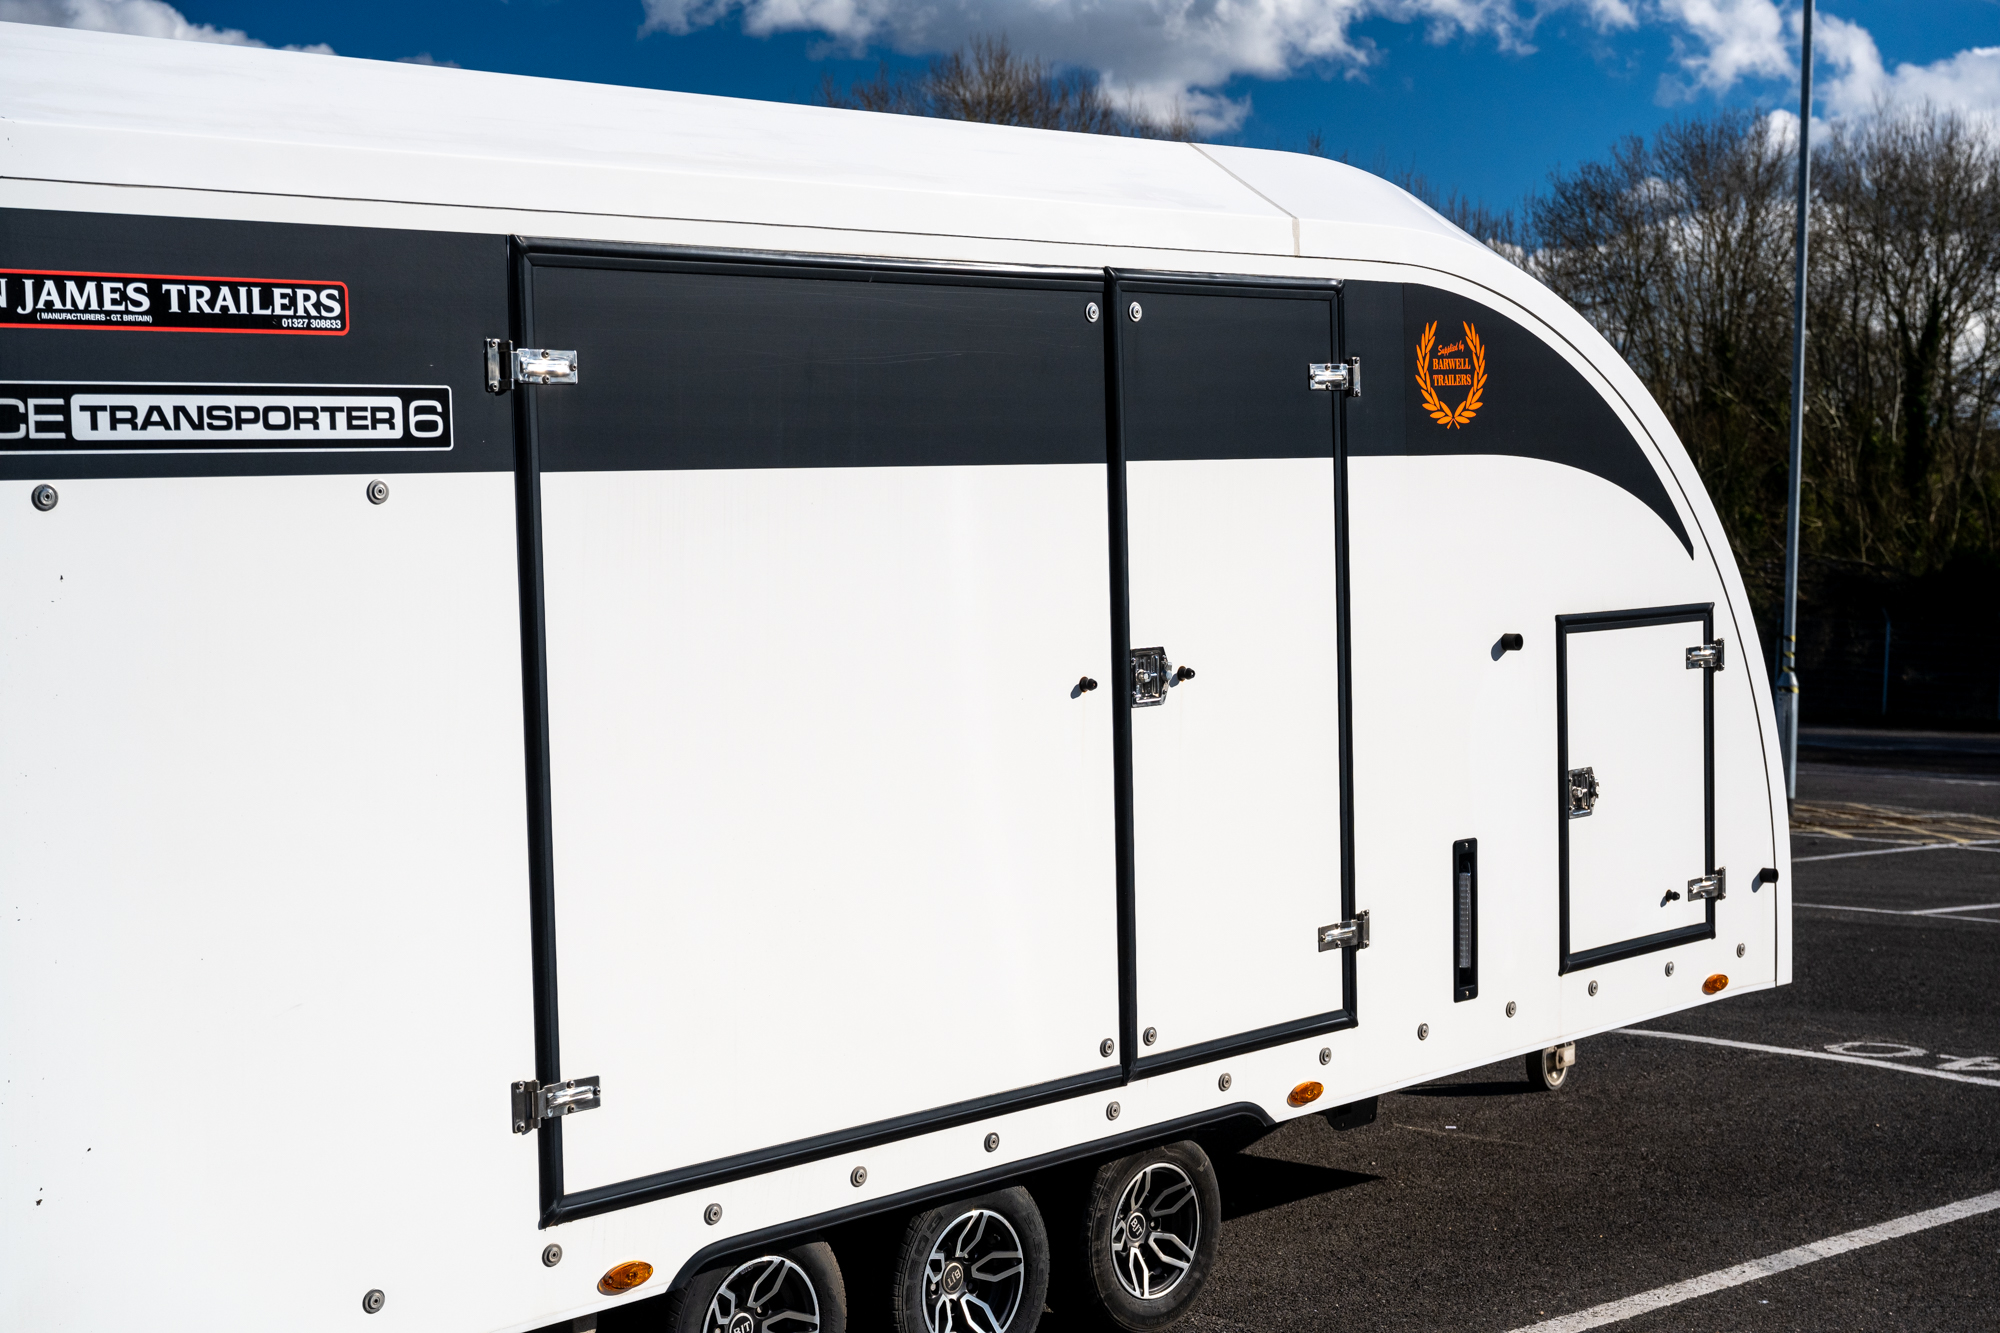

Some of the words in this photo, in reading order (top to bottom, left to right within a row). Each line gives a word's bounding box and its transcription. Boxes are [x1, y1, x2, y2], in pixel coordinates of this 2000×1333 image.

[16, 278, 151, 315] JAMES
[161, 283, 342, 318] TRAILERS
[123, 314, 153, 324] BRITAIN)
[281, 318, 309, 328] 01327
[310, 319, 342, 329] 308833
[1438, 343, 1458, 356] Supplied
[1459, 340, 1465, 352] by
[1432, 358, 1471, 370] BARWELL
[1432, 374, 1472, 386] TRAILERS
[78, 404, 396, 432] TRANSPORTER
[408, 399, 444, 438] 6
[1130, 1217, 1143, 1236] BJT
[947, 1268, 962, 1288] BJT
